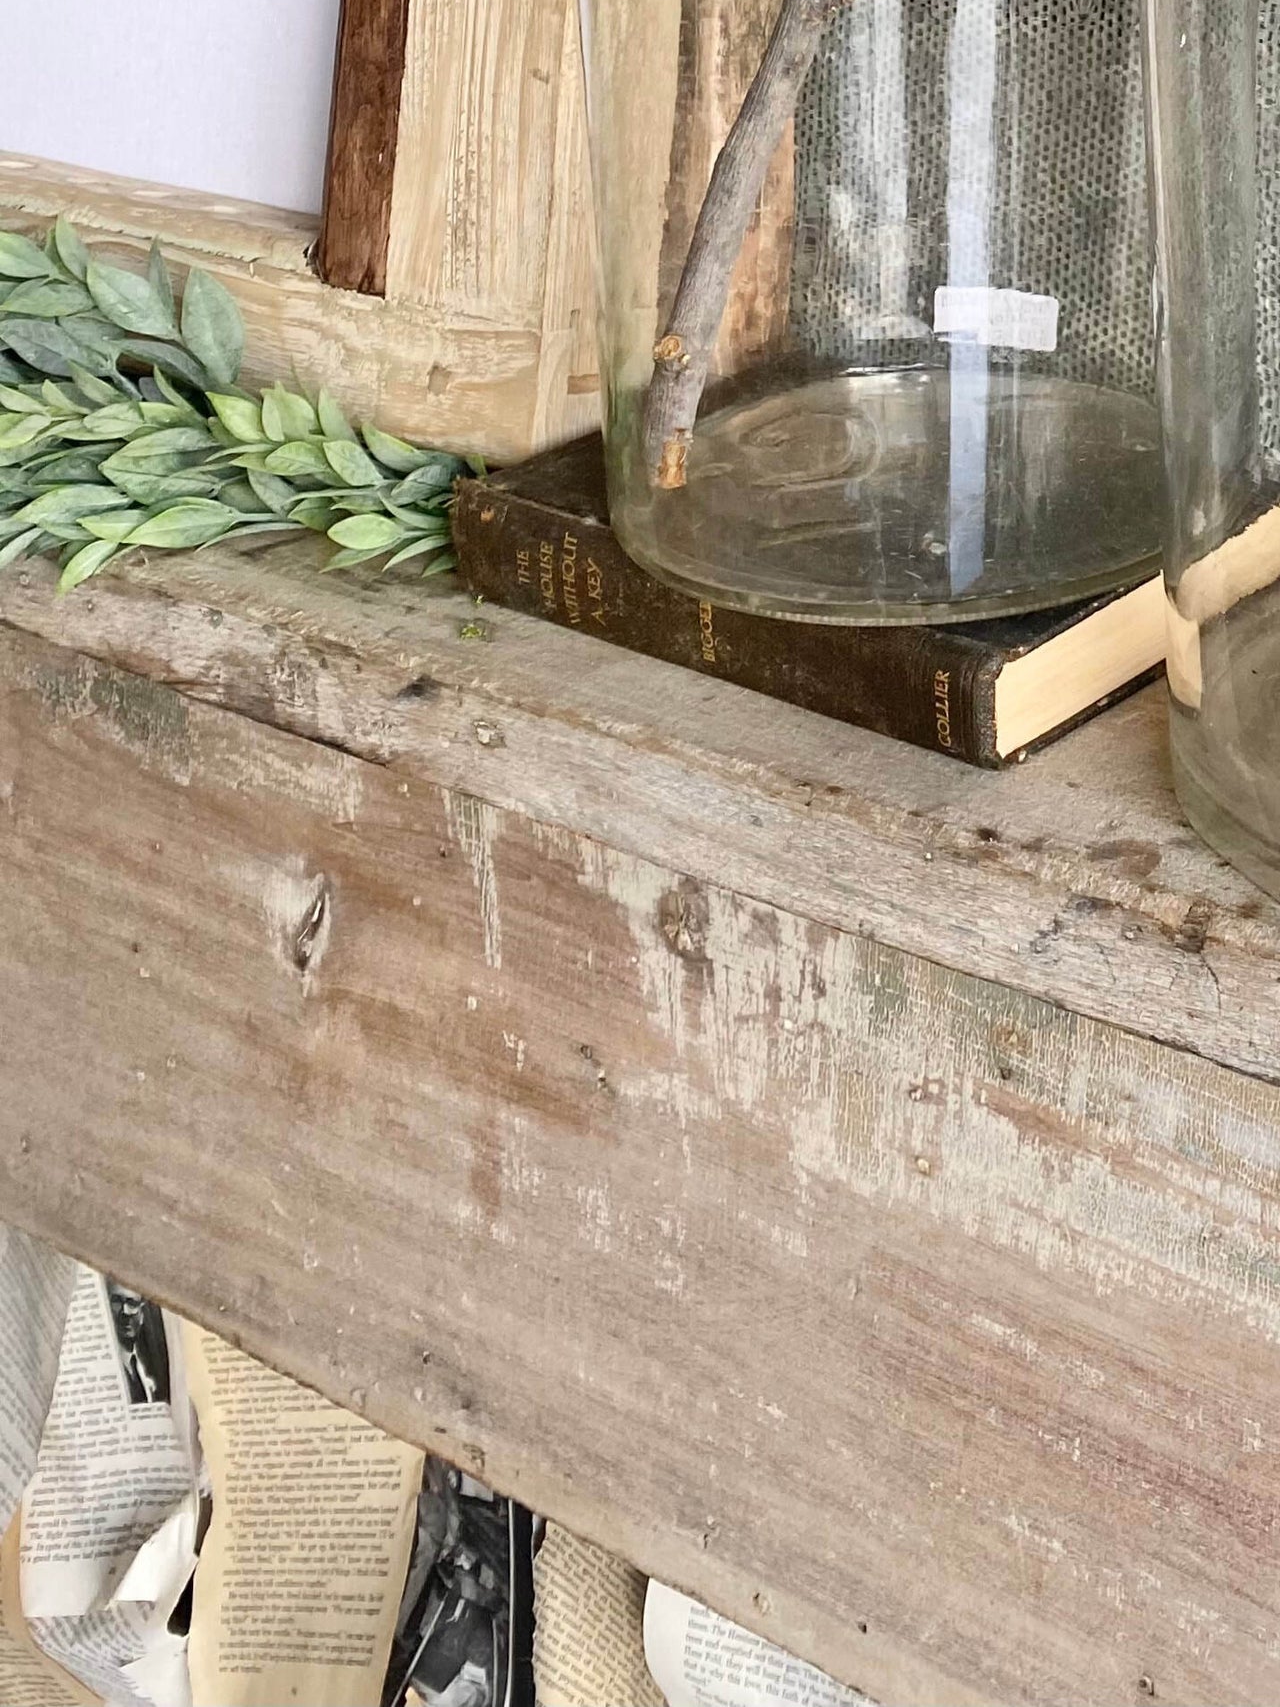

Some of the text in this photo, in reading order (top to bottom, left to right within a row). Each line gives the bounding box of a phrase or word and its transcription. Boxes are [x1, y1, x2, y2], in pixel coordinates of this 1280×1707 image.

[516, 549, 530, 585] THE
[540, 541, 556, 611] HOUSE
[562, 531, 580, 624] WITHOUT
[587, 557, 606, 626] A KEY
[934, 670, 952, 747] COLLIER
